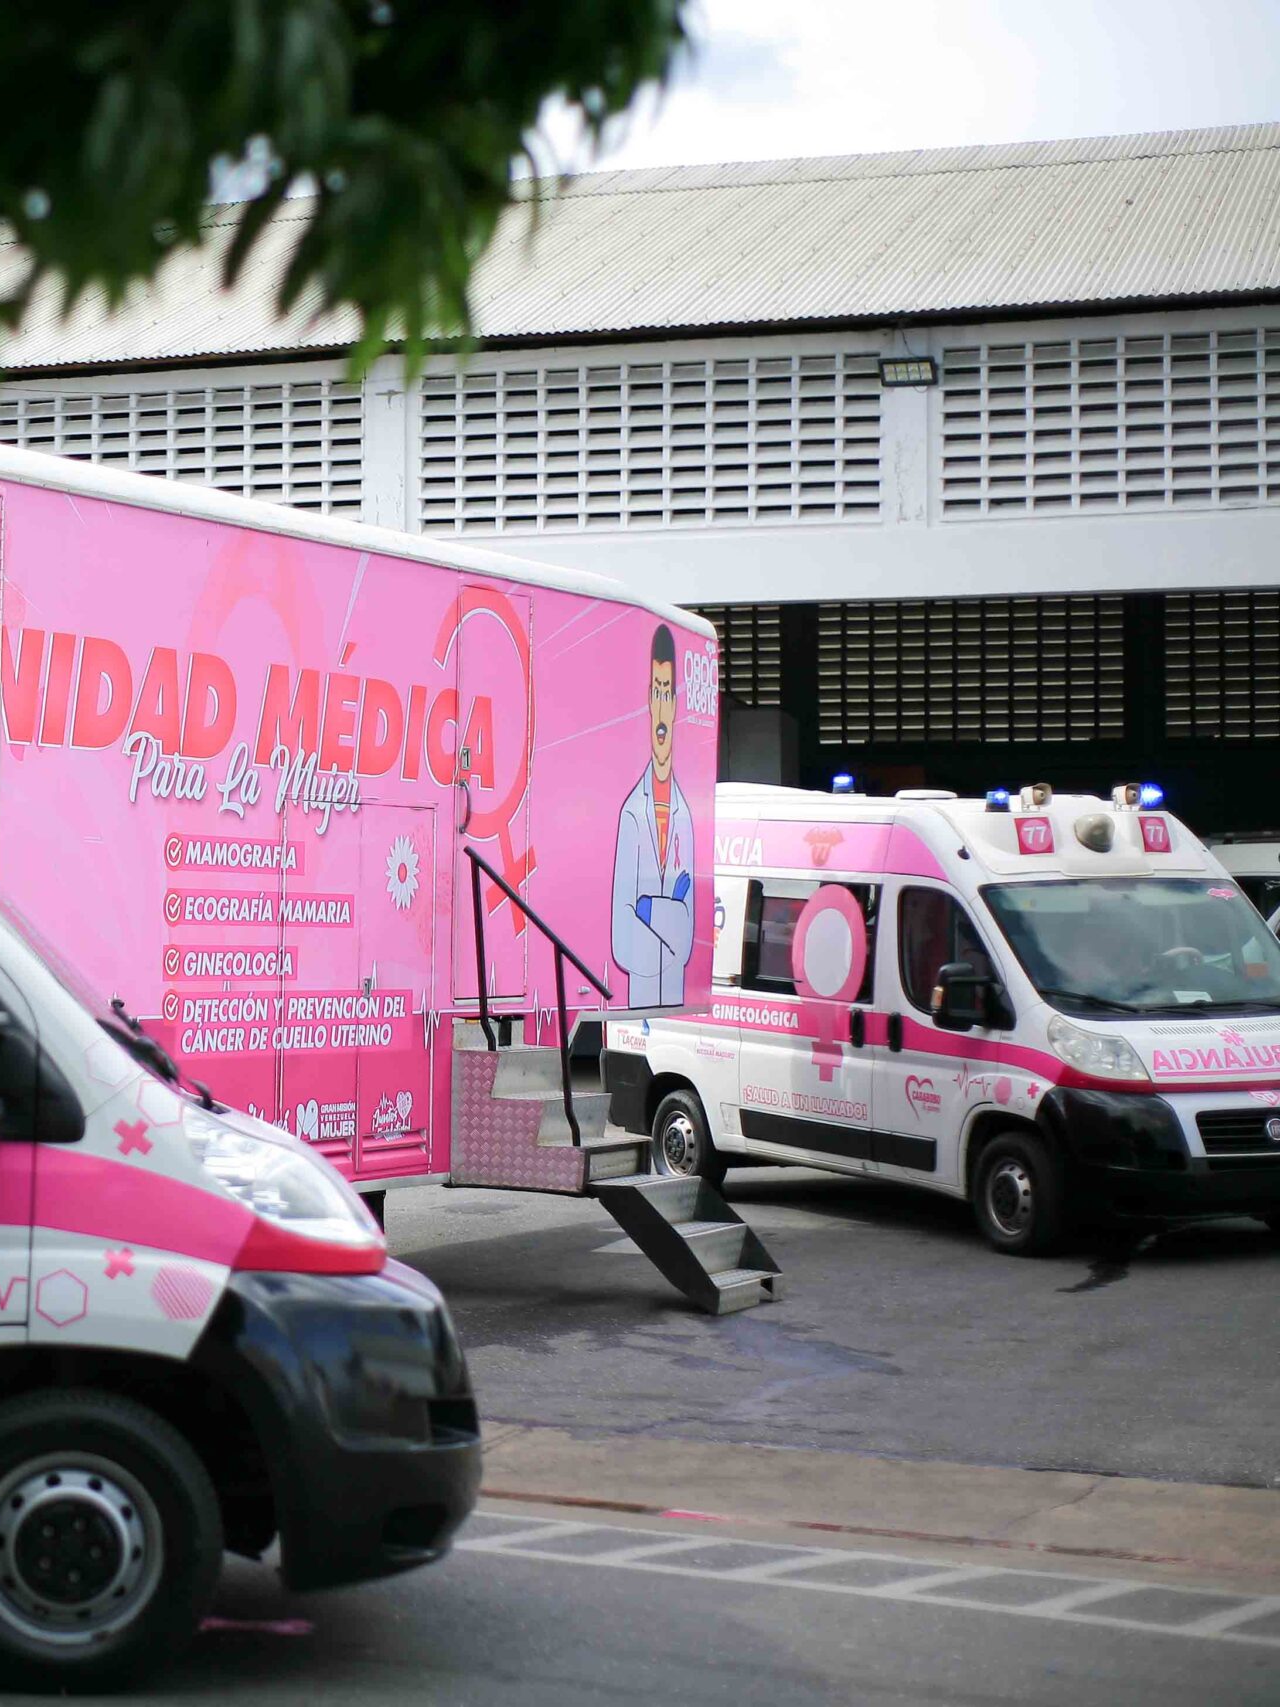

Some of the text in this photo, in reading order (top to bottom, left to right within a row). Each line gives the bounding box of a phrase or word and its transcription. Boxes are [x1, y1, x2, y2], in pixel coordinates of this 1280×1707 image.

[253, 642, 494, 791] MÉDICA
[122, 731, 363, 834] Para La Mujer
[1023, 825, 1047, 844] 77
[1145, 825, 1164, 843] 77
[184, 891, 351, 924] ECOGRAFÍA MAMARIA
[183, 947, 294, 976] GINECOLOGÍA
[182, 991, 268, 1023] DETECCIÓN
[273, 998, 285, 1021] Y
[383, 996, 406, 1019] DEL
[712, 1004, 799, 1028] GINECOLÓGICA
[181, 1019, 392, 1053] CÁNCER DE CUELLO UTERINO
[320, 1103, 337, 1114] GRAN
[320, 1112, 356, 1122] VENEZUELA
[781, 1091, 792, 1109] A
[792, 1093, 810, 1111] UN
[810, 1096, 868, 1120] LLAMADO!
[320, 1121, 356, 1139] MUJER
